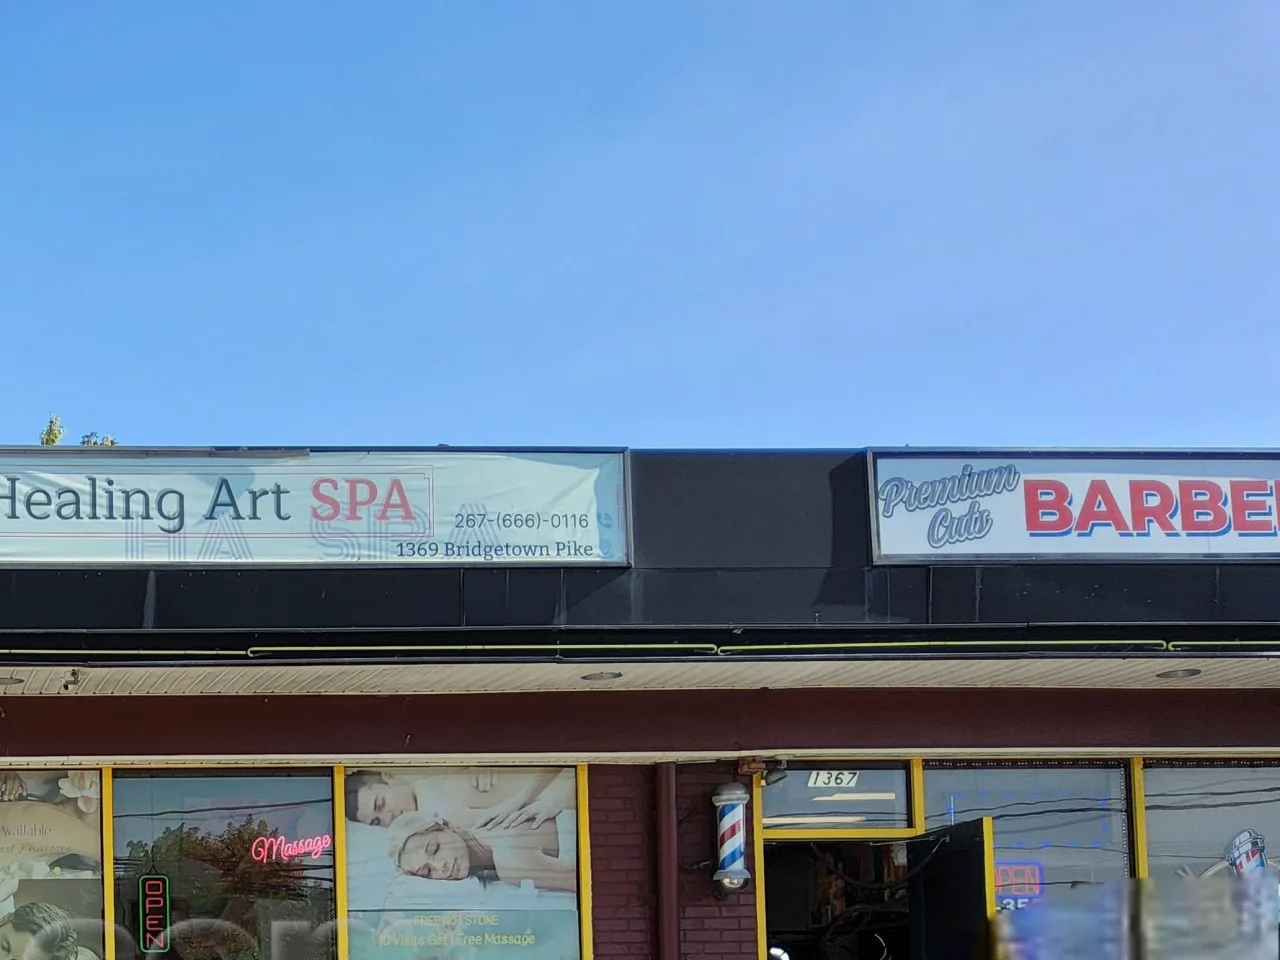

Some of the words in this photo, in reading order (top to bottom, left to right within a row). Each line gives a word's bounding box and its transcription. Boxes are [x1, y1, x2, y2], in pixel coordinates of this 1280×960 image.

[203, 475, 291, 521] Art
[310, 477, 417, 522] SPA
[879, 463, 1020, 518] Premium
[455, 511, 589, 530] 267-(666)-0116
[1023, 479, 1280, 538] BARBE
[927, 500, 993, 549] Cuts
[396, 541, 439, 558] 1369
[443, 540, 550, 561] Bridgetown
[555, 540, 593, 557] Pike
[812, 772, 858, 786] 1367
[251, 835, 331, 864] Massage
[995, 864, 1041, 896] PEN
[145, 880, 164, 948] OPEN
[464, 913, 500, 926] STONE
[456, 932, 483, 946] Free
[484, 931, 536, 947] Massage
